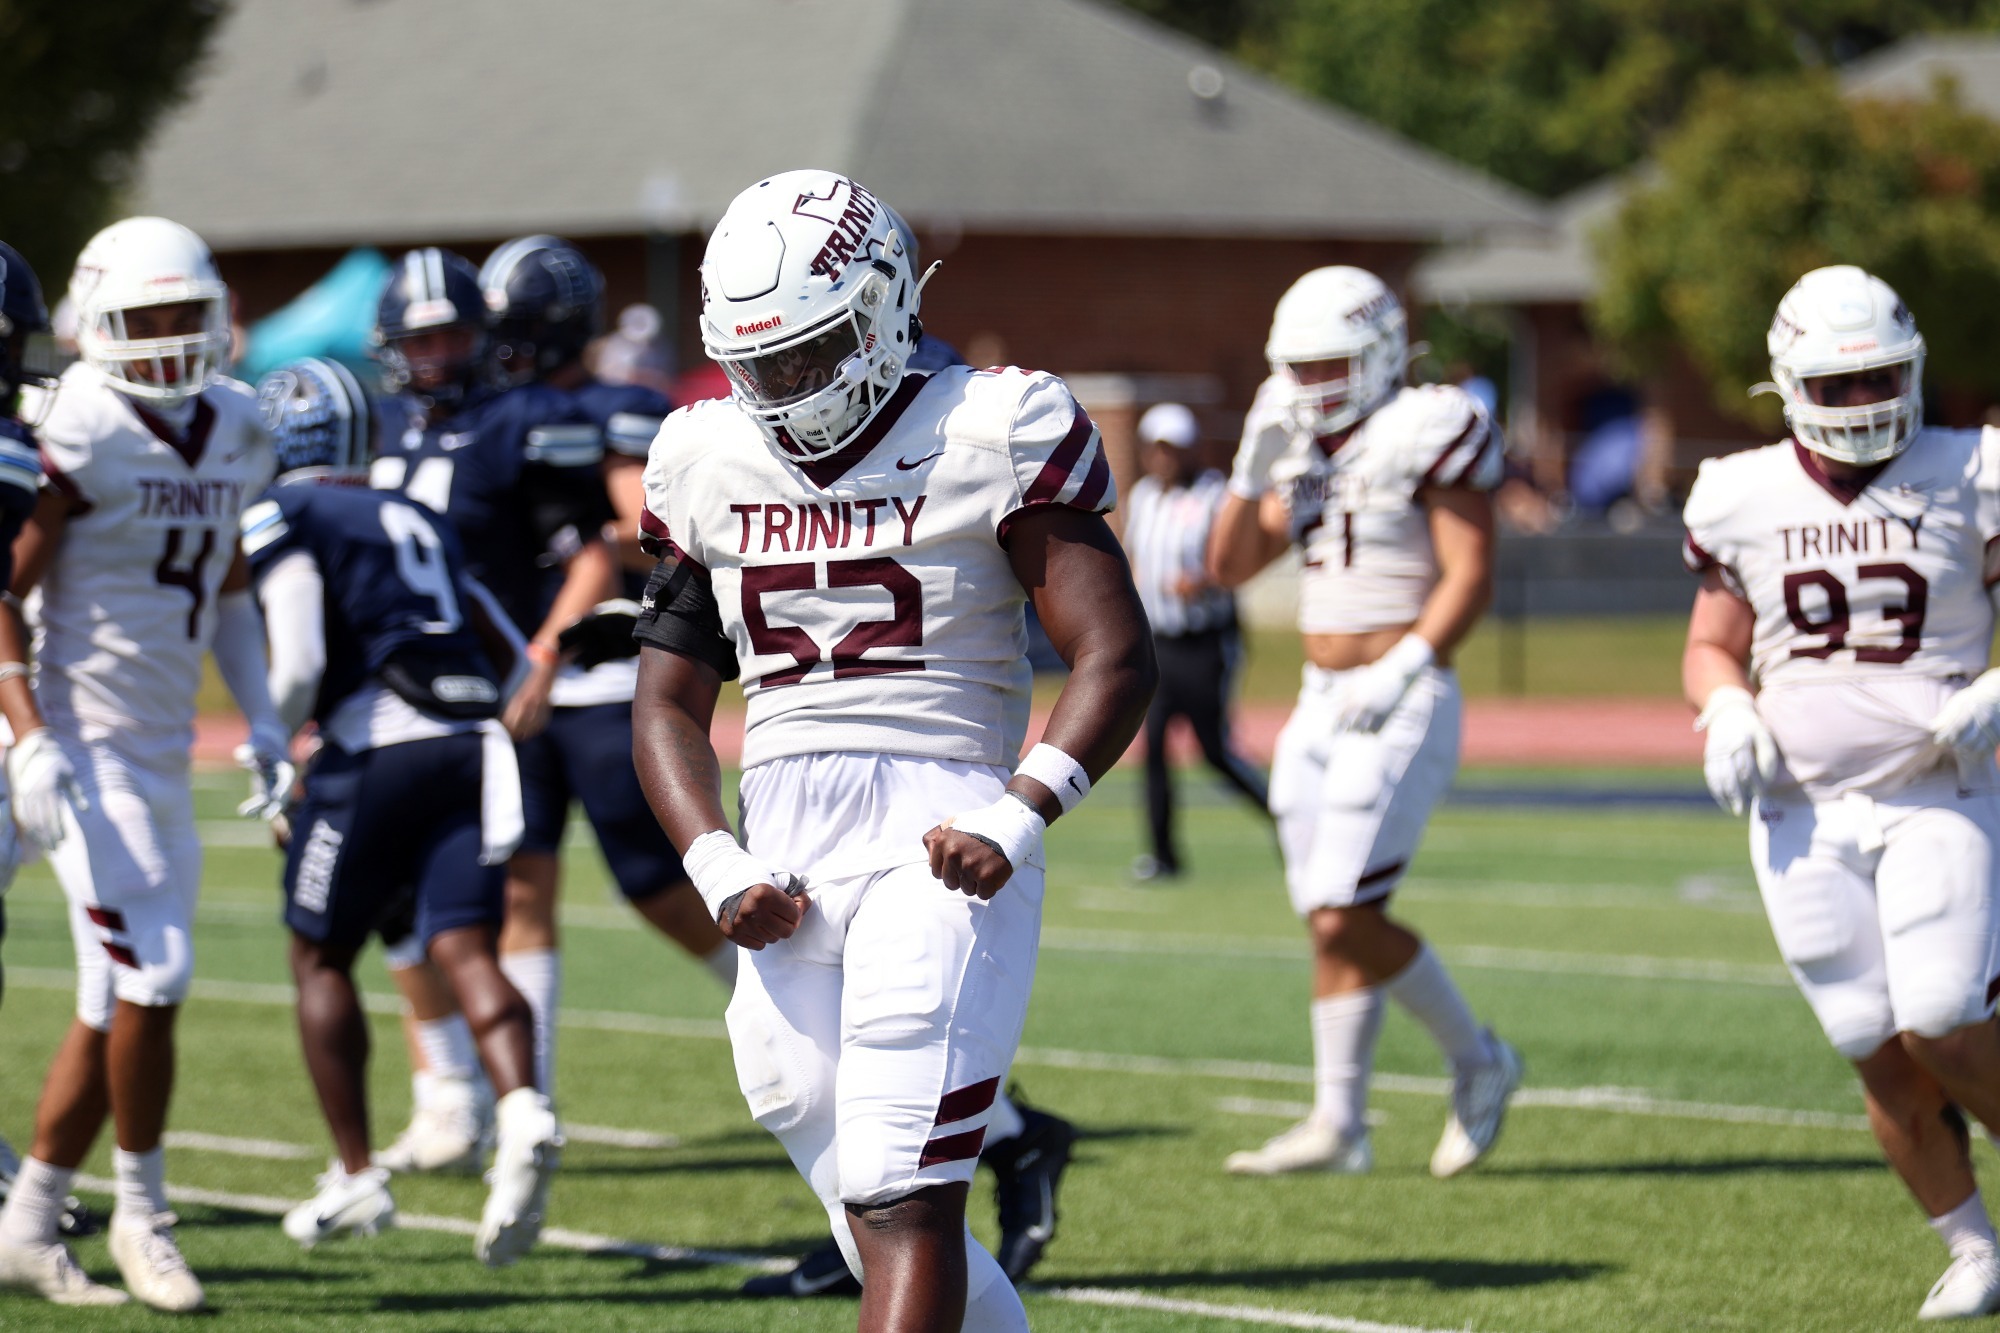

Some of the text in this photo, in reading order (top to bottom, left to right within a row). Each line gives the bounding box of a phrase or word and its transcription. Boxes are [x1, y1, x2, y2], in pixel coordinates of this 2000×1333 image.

[735, 315, 782, 337] Riddell
[137, 478, 245, 518] TRINITY
[731, 495, 928, 553] TRINITY
[1777, 514, 1924, 561] TRINITY
[156, 527, 217, 641] 4
[379, 501, 463, 634] 9
[741, 556, 926, 689] 52
[1784, 563, 1928, 664] 93
